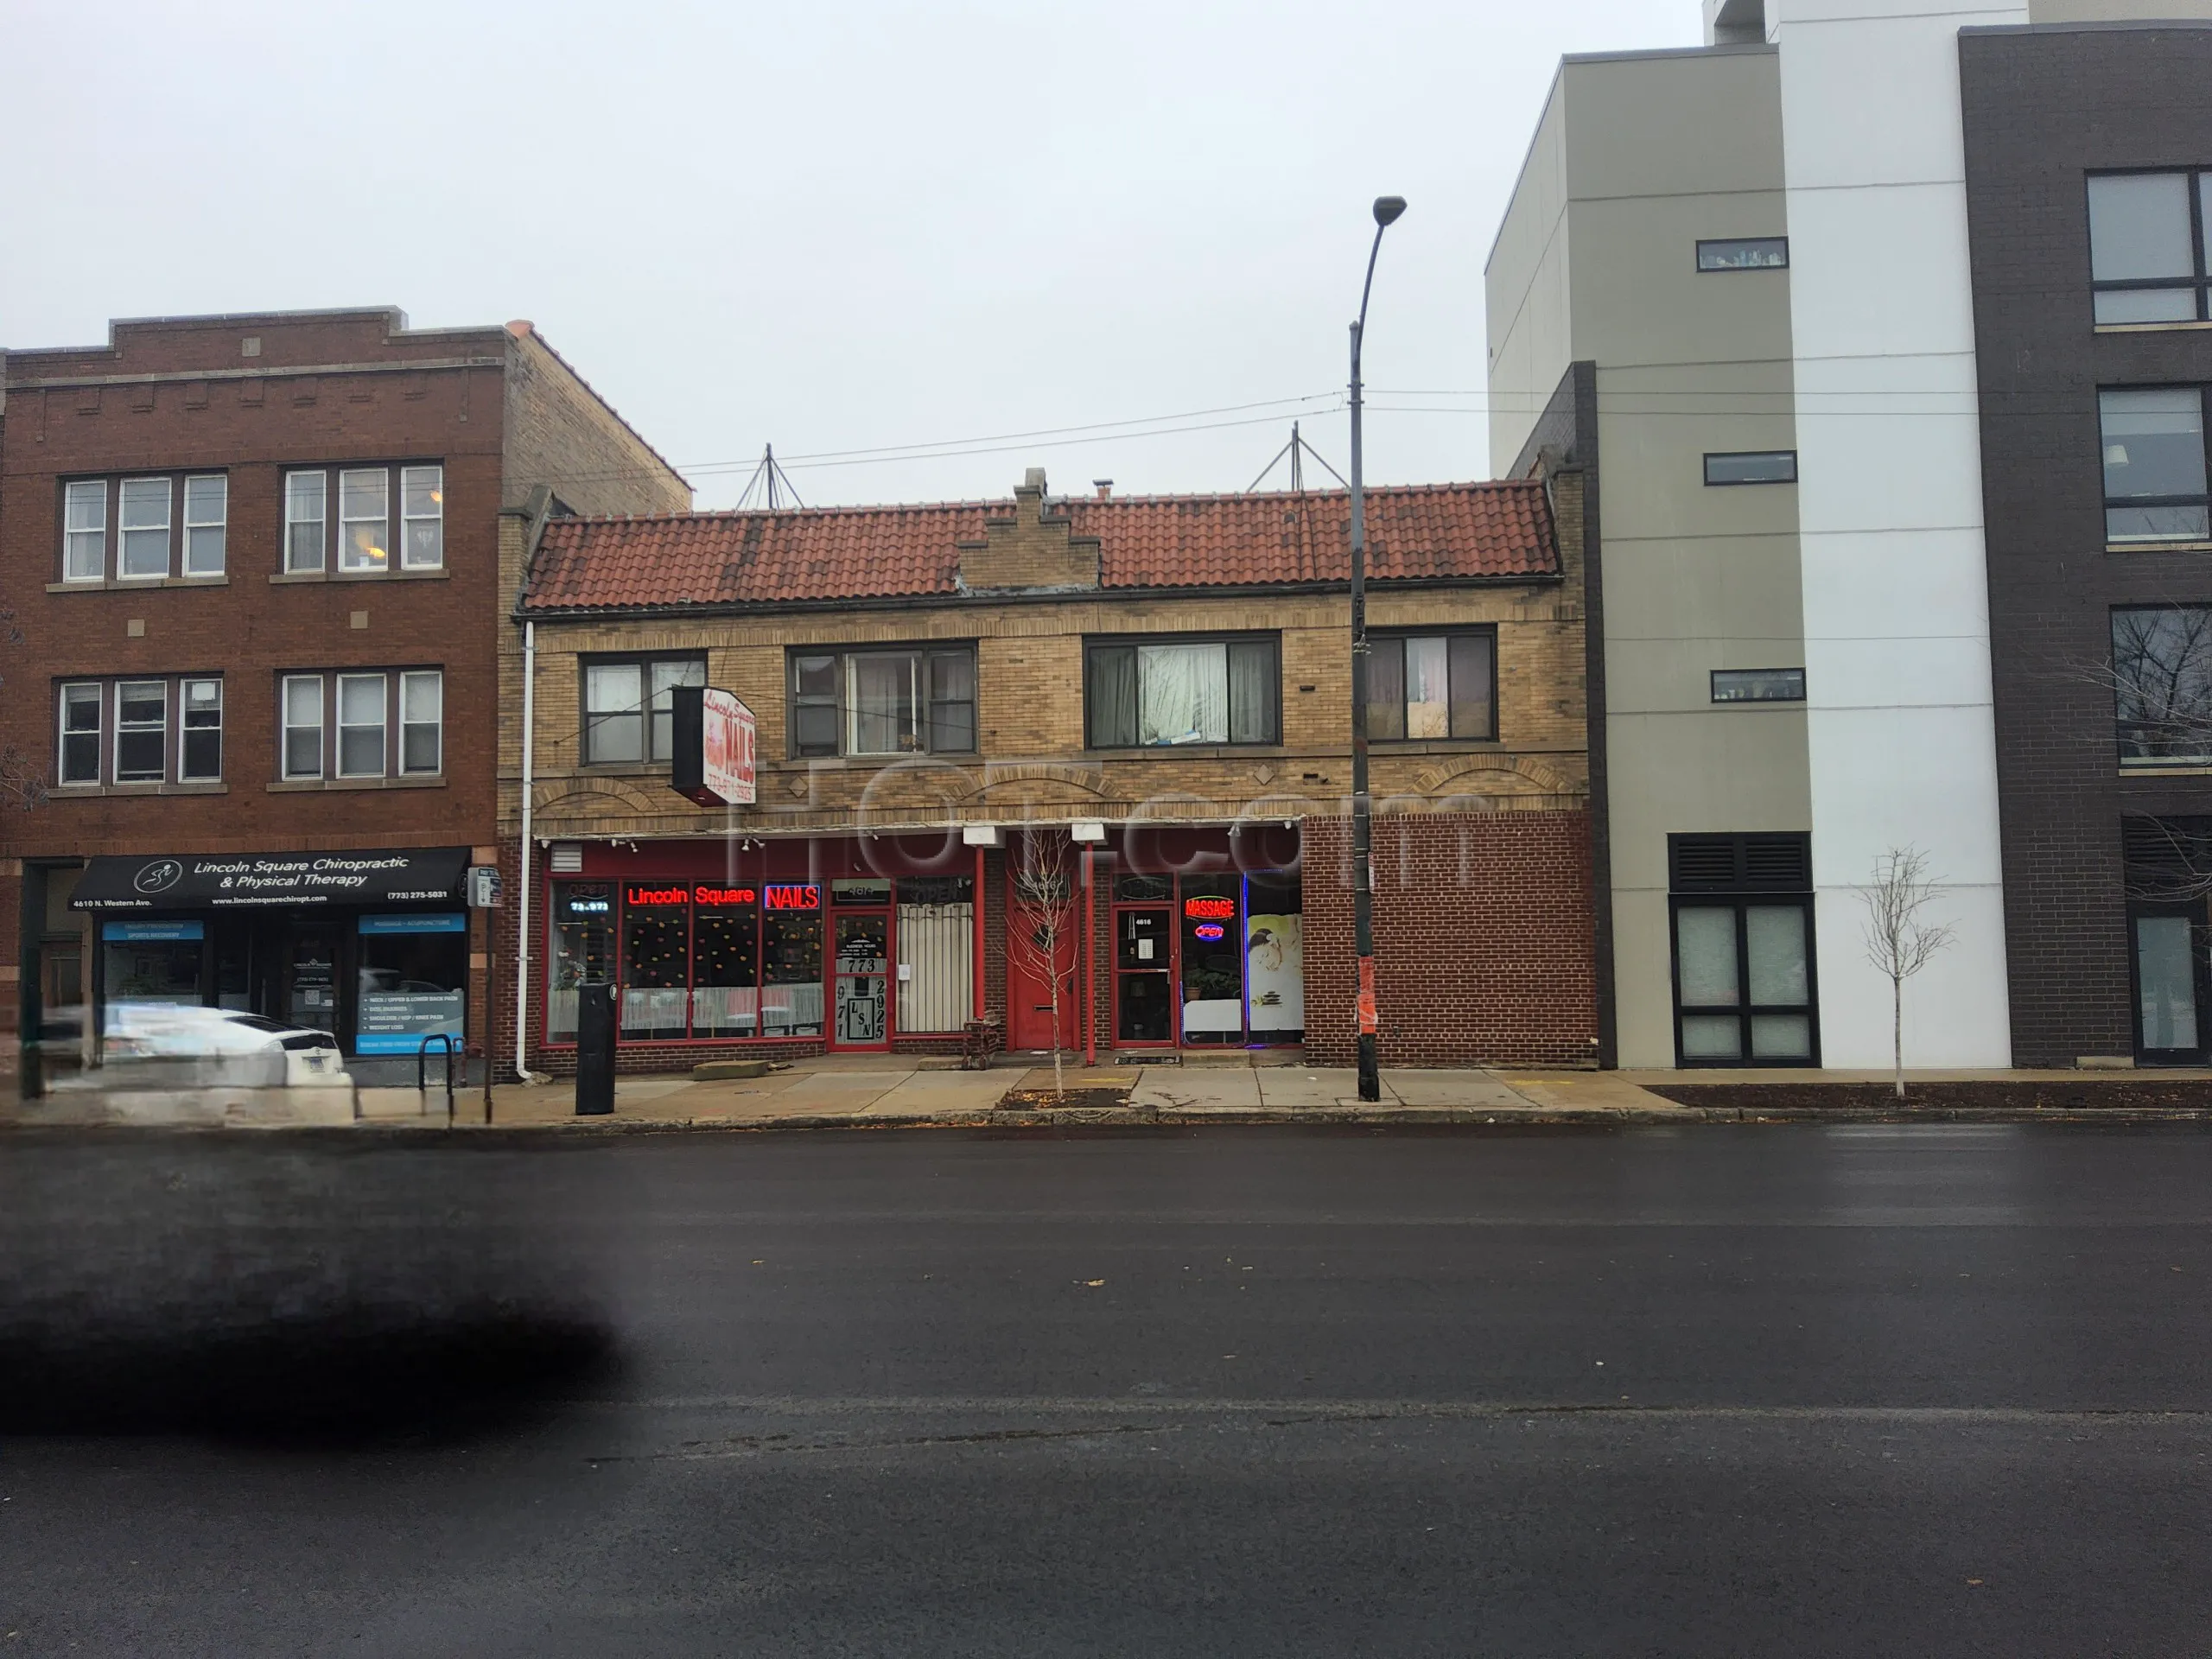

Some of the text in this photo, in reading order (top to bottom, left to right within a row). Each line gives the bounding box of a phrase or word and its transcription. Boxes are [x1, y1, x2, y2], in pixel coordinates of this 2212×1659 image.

[704, 690, 734, 720] Lincoln
[723, 717, 754, 785] NAILS
[194, 856, 410, 874] Lincoln Square Chiropractic
[220, 874, 367, 889] & Physical Therapy
[212, 895, 327, 906] www.lincolnsquarechiropt.com
[388, 891, 447, 900] (773) 275-5031
[628, 886, 818, 908] Lincoln Square NAILS
[1185, 899, 1235, 916] MASSAGE
[1195, 926, 1224, 938] OPEN
[849, 958, 874, 973] 773
